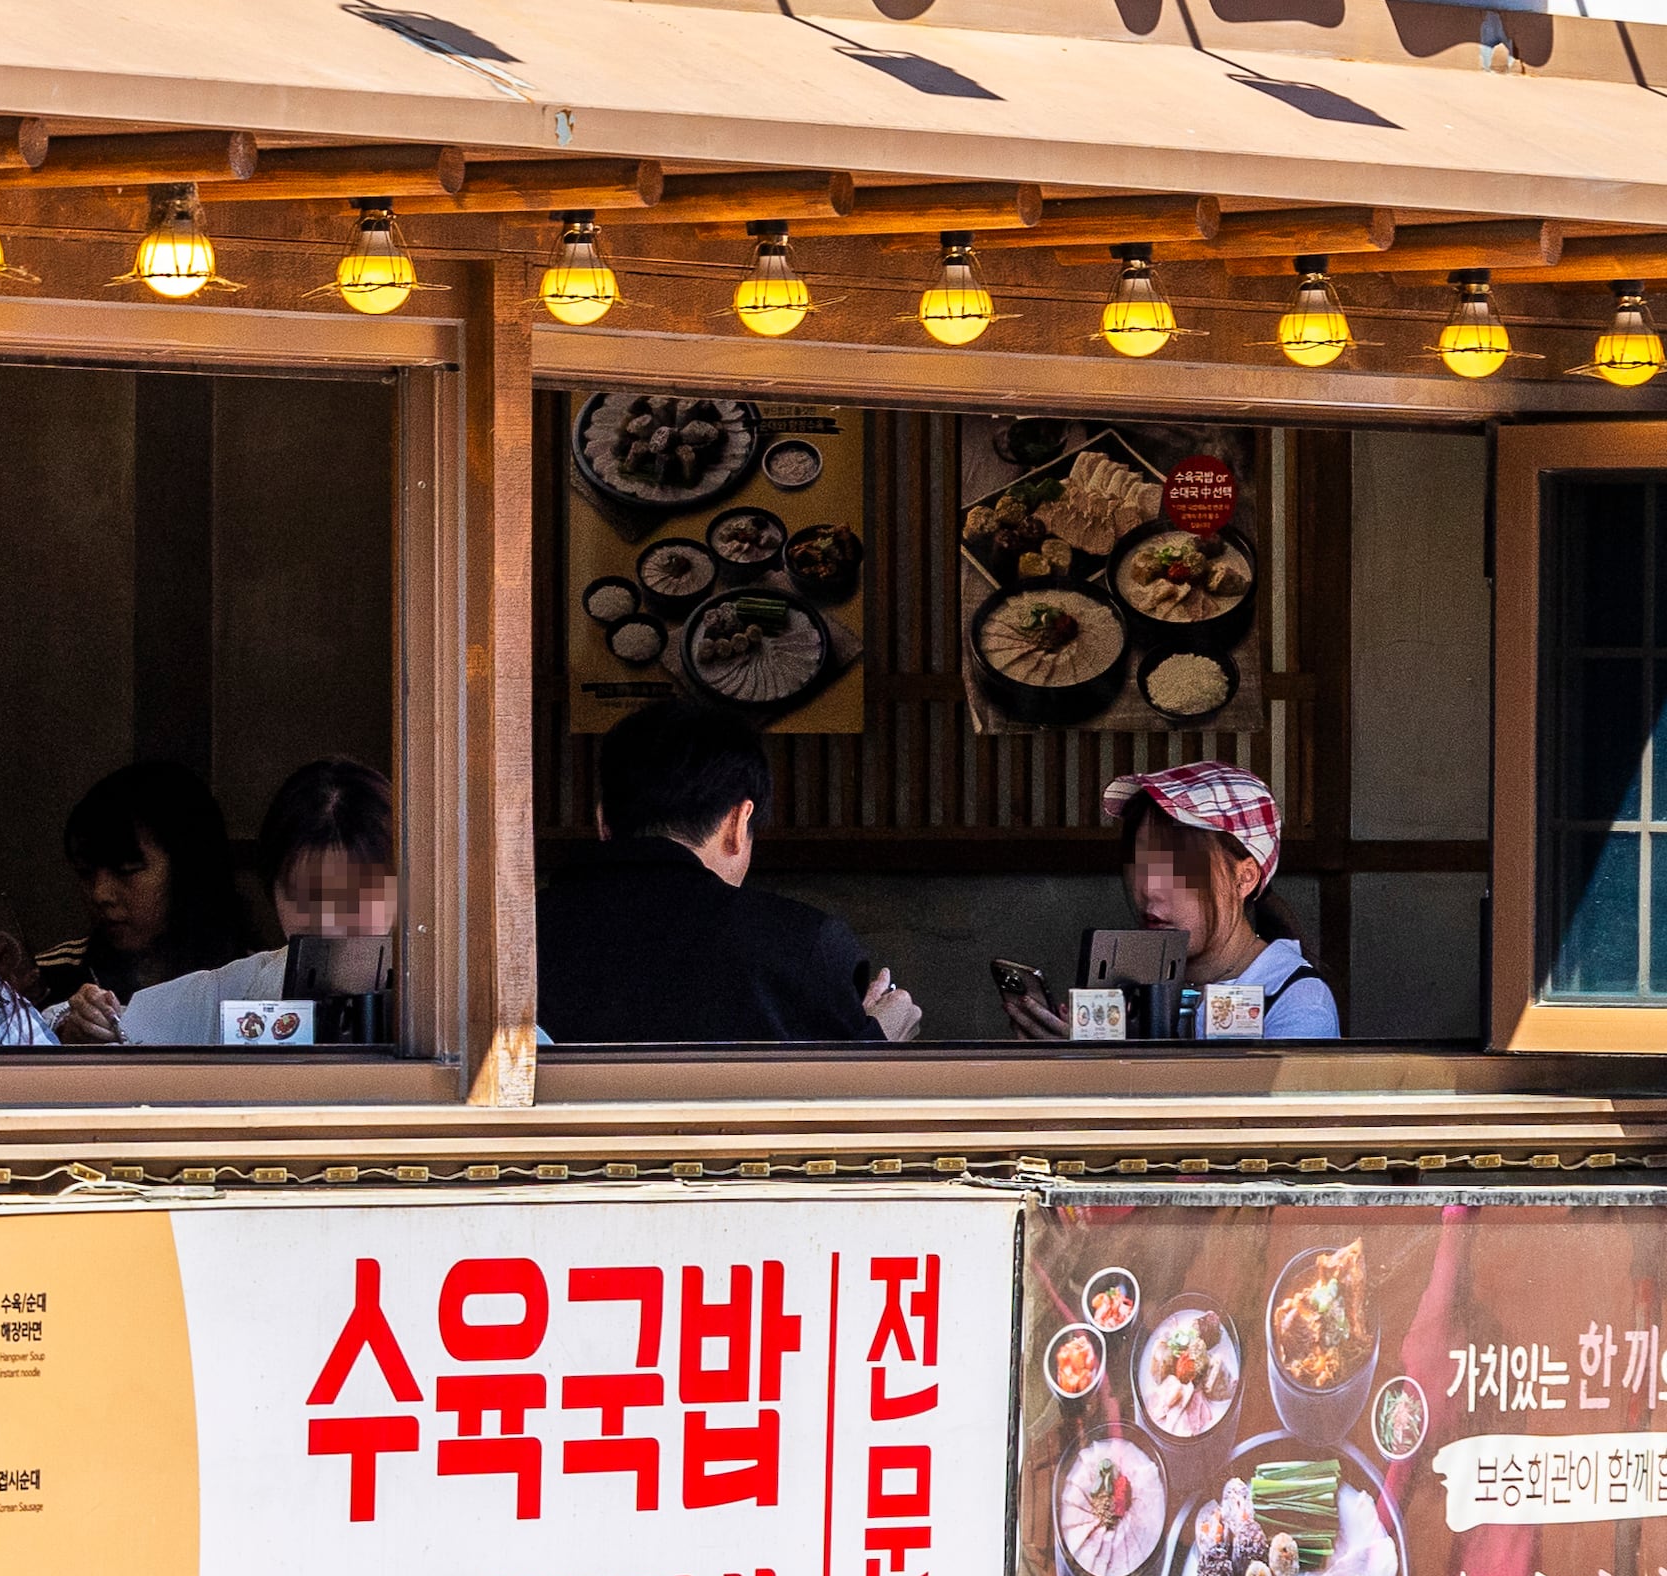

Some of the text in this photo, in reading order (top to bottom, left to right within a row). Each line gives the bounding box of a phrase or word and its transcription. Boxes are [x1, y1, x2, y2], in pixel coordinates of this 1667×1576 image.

[1175, 471, 1229, 484] 수육국밥 or
[1169, 485, 1199, 499] 순대국
[1212, 485, 1233, 499] 선택
[1, 1293, 47, 1314] 수육/순대
[1, 1321, 42, 1342] 해장라면
[1447, 1319, 1667, 1413] 가치있는 한 끼
[305, 1257, 801, 1523] 수육국밥
[1475, 1449, 1600, 1507] 보승회관이
